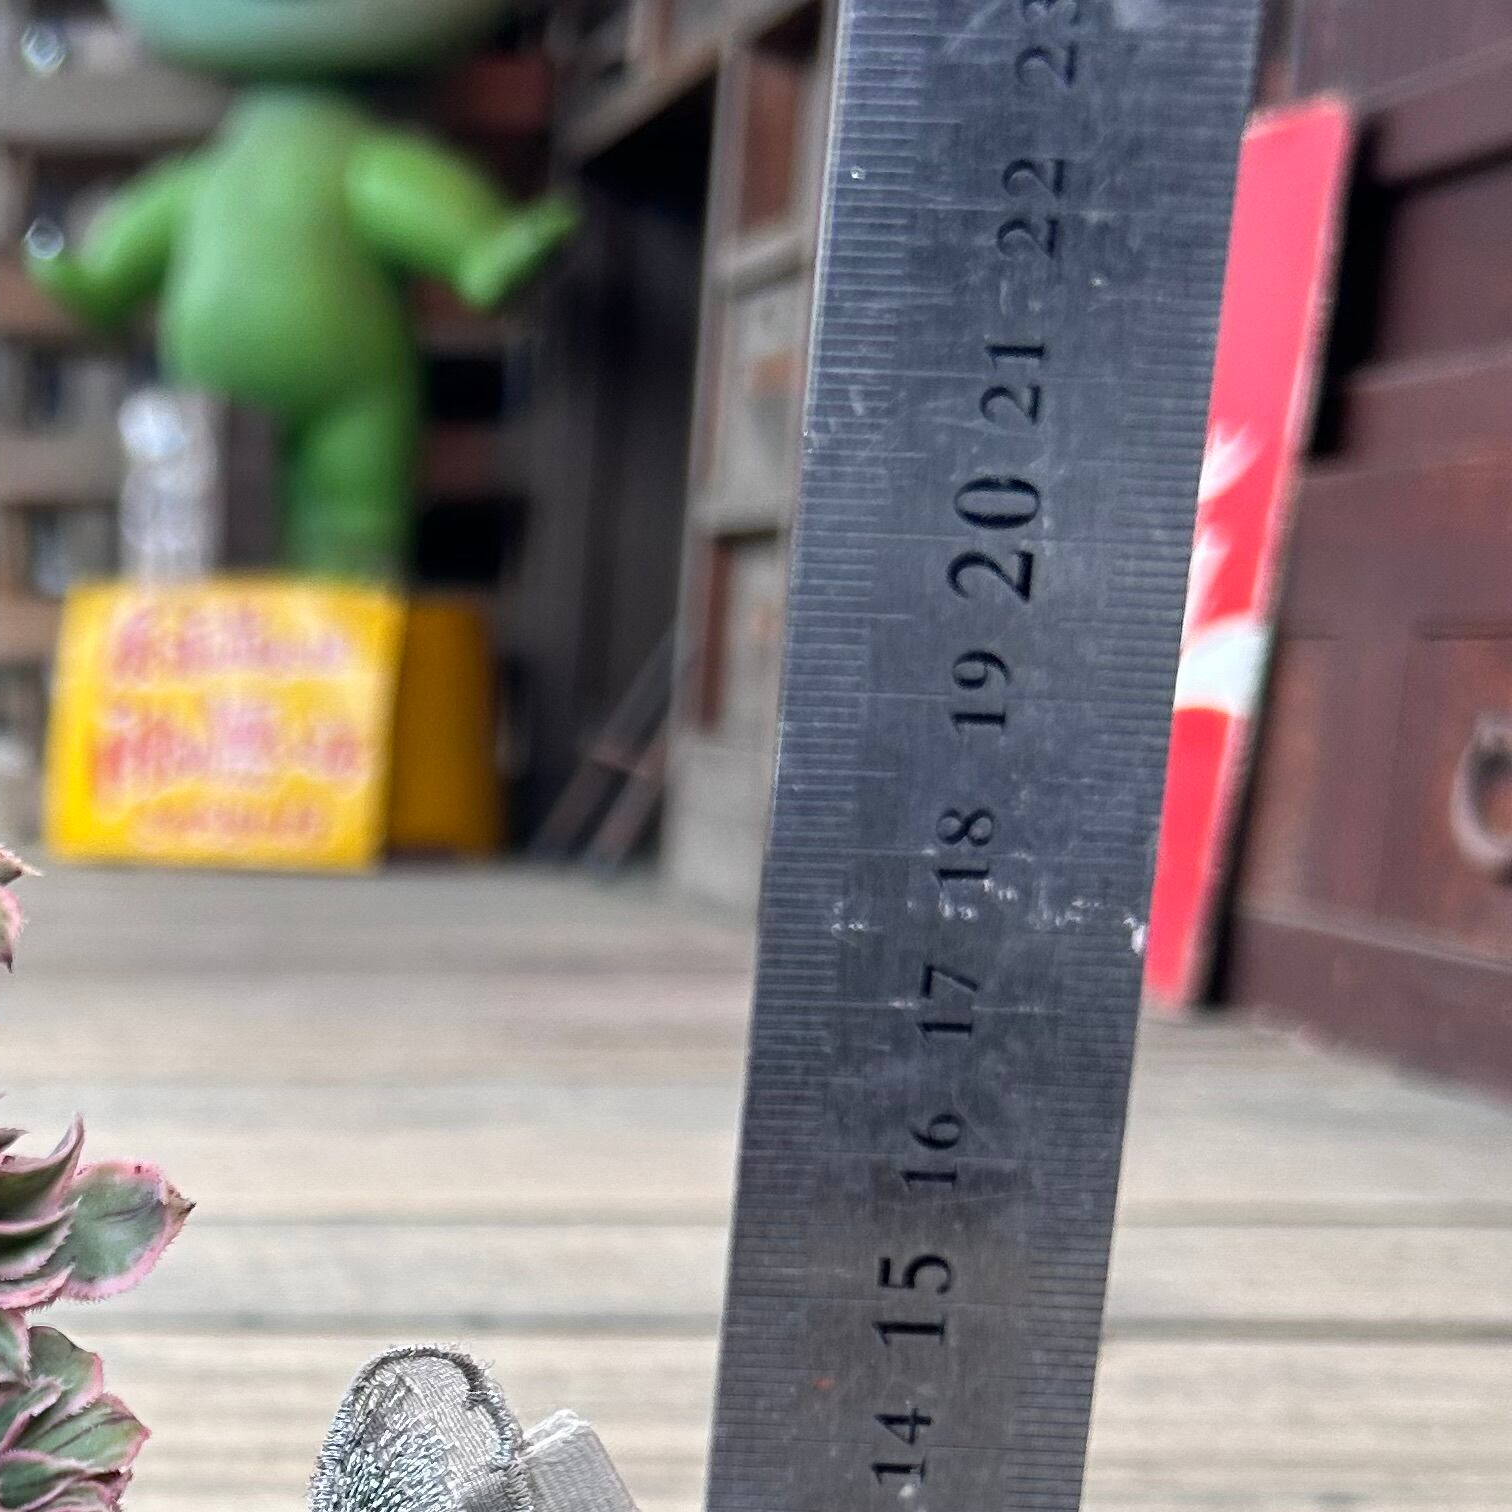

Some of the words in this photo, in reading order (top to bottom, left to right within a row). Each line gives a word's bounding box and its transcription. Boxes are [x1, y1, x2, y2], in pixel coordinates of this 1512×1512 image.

[996, 158, 1066, 260] 22
[979, 343, 1046, 426] 21
[945, 474, 1041, 602] 20
[950, 650, 1011, 735] 19
[934, 807, 995, 888] 18
[916, 961, 979, 1044] 17
[900, 1112, 963, 1192] 16
[872, 1254, 954, 1347] 15
[871, 1407, 934, 1486] 14
